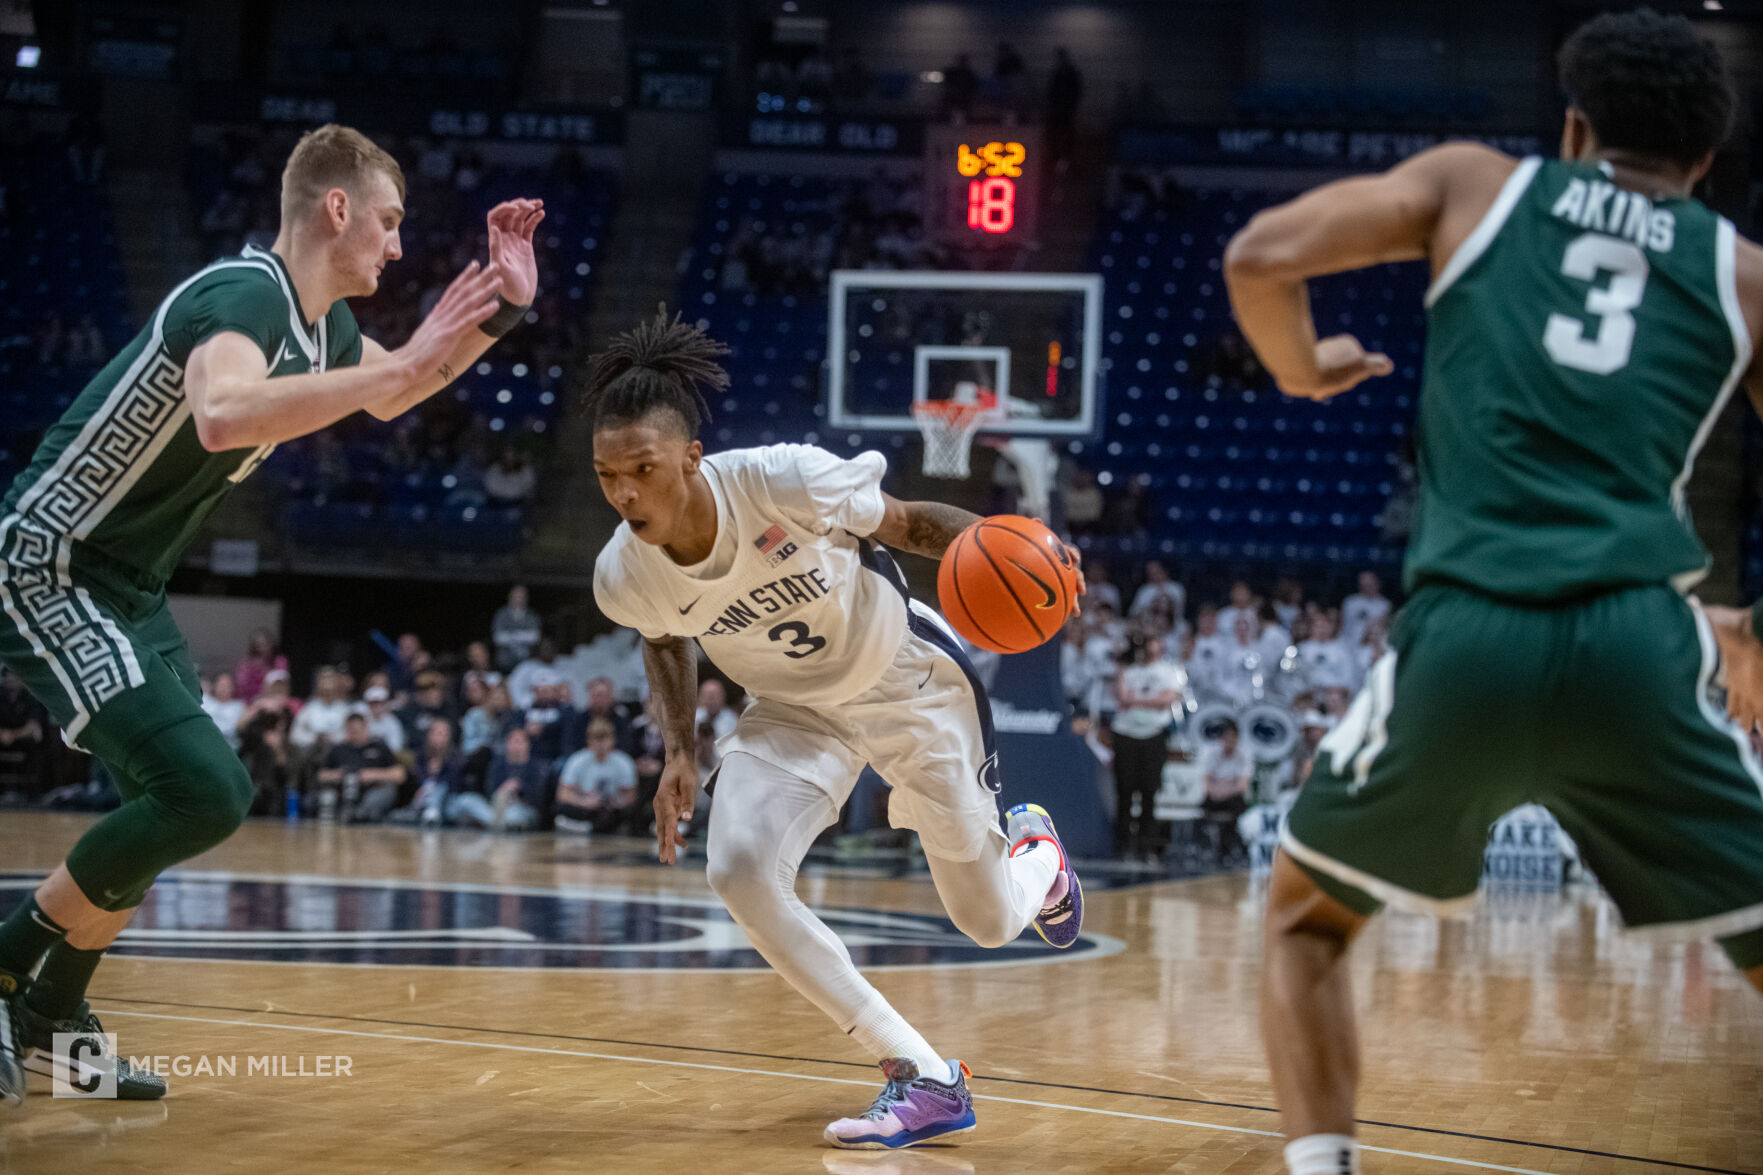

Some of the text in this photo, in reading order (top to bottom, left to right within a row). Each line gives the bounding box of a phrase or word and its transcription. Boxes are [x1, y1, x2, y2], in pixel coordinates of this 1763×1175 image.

[3, 82, 60, 106] AME
[261, 97, 336, 121] DEAR
[432, 110, 594, 140] OLD STATE
[749, 120, 897, 149] DEAR OLD
[957, 142, 1026, 177] 6:52
[967, 177, 1016, 234] 18
[1552, 177, 1675, 253] AKINS
[1544, 232, 1650, 374] 3
[748, 568, 831, 613] STATE
[768, 621, 828, 659] 3
[1499, 820, 1558, 847] AKE
[1492, 855, 1558, 881] OISE
